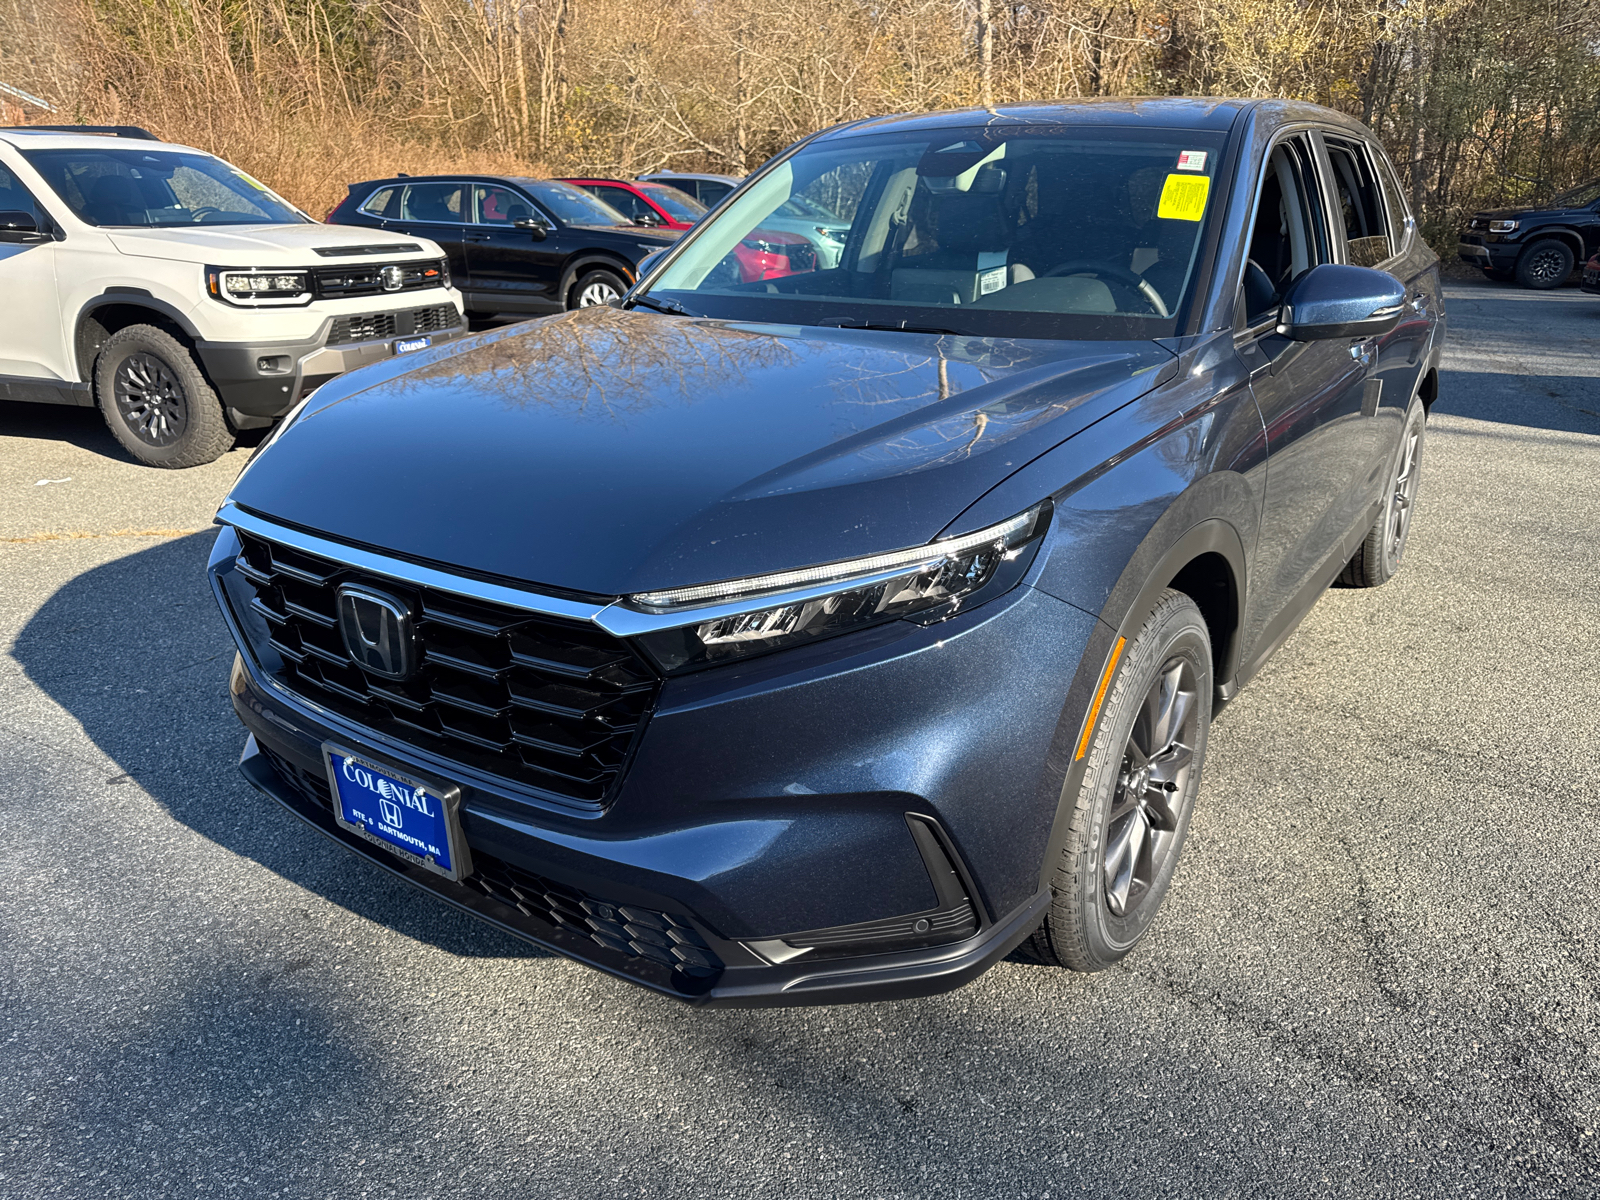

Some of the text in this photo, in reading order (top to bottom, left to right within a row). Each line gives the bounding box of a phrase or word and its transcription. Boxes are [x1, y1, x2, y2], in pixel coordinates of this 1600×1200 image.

[343, 763, 435, 818] COLONIAL
[352, 809, 441, 856] RTE. 6 DARTMOUTH, MA
[364, 832, 426, 867] COLONIAL HONDA
